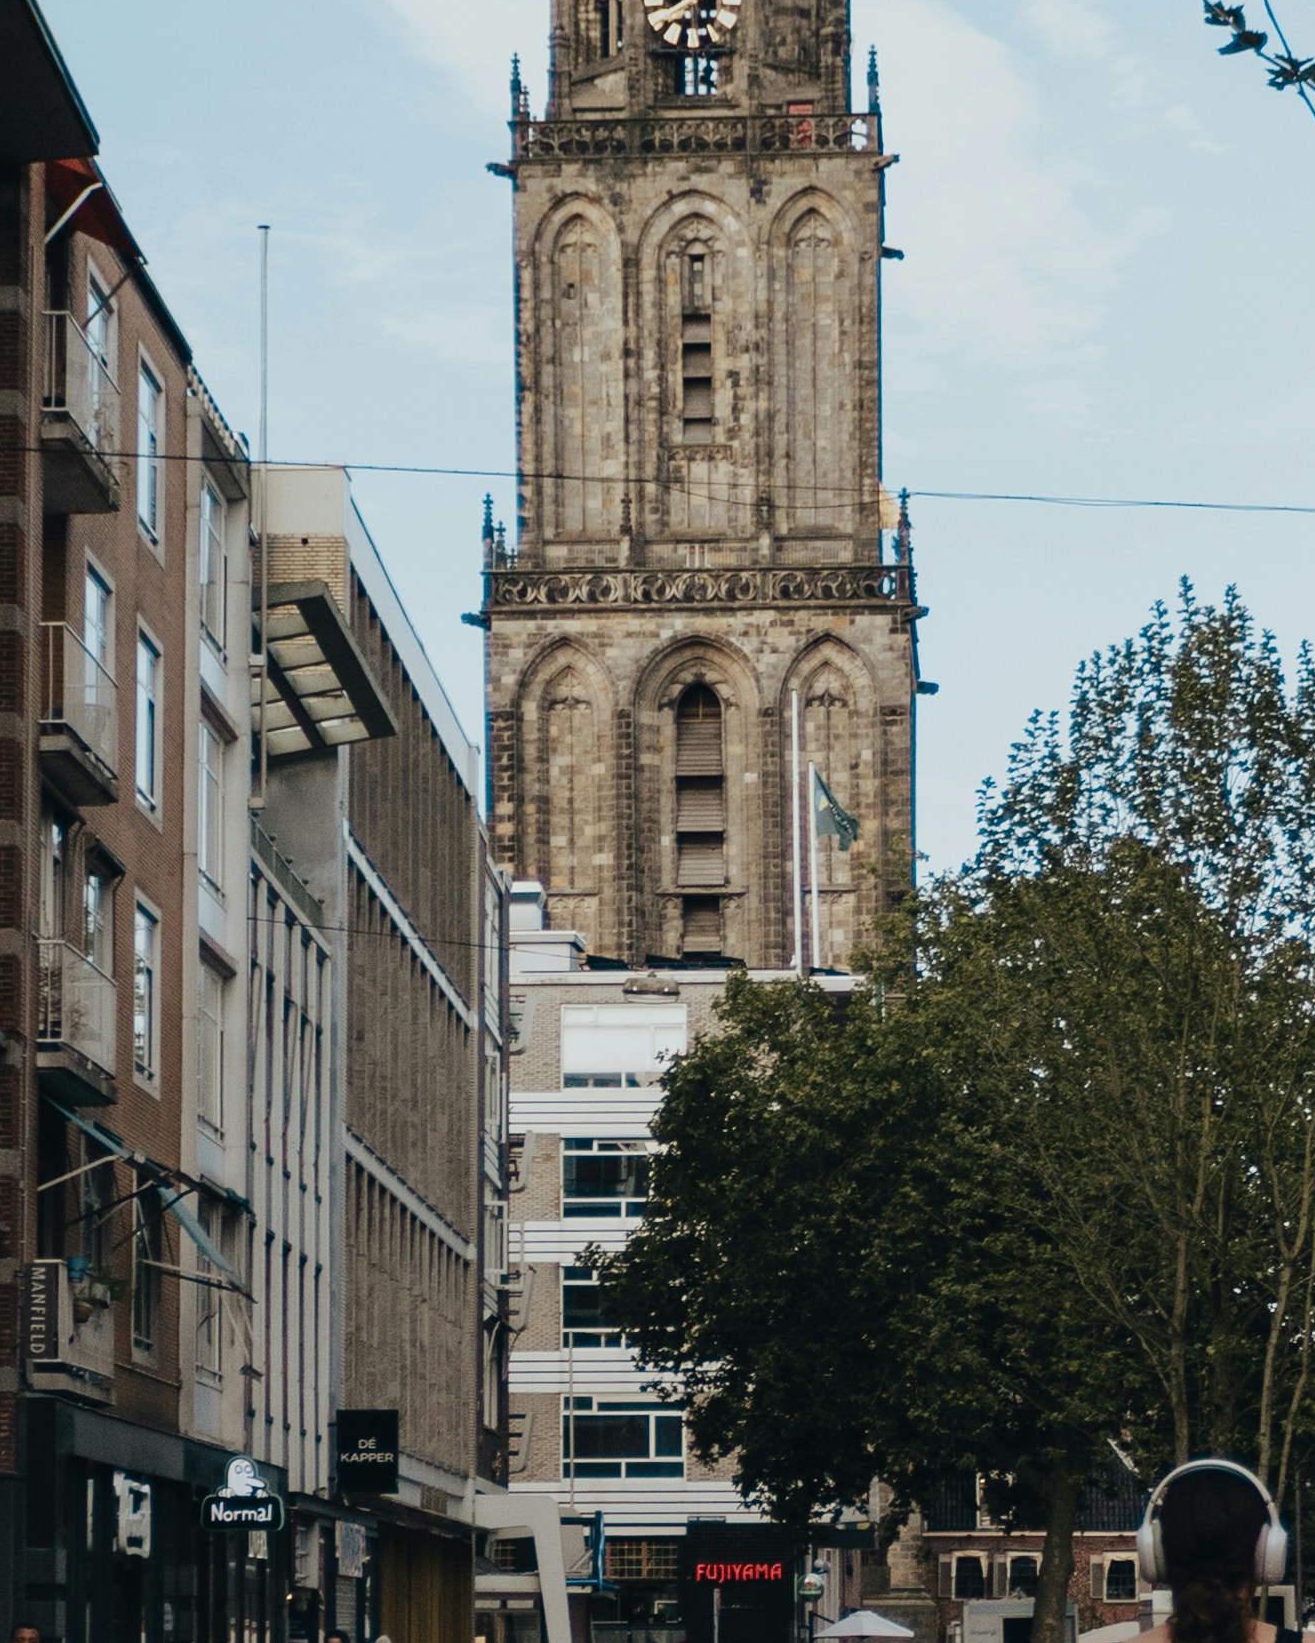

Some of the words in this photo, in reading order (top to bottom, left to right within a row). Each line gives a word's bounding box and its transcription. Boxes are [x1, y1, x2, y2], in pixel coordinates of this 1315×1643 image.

[30, 1267, 46, 1354] MANFIELD
[340, 1452, 394, 1463] KAPPER
[210, 1501, 273, 1523] Normal
[696, 1563, 782, 1583] FUJIYAMA
